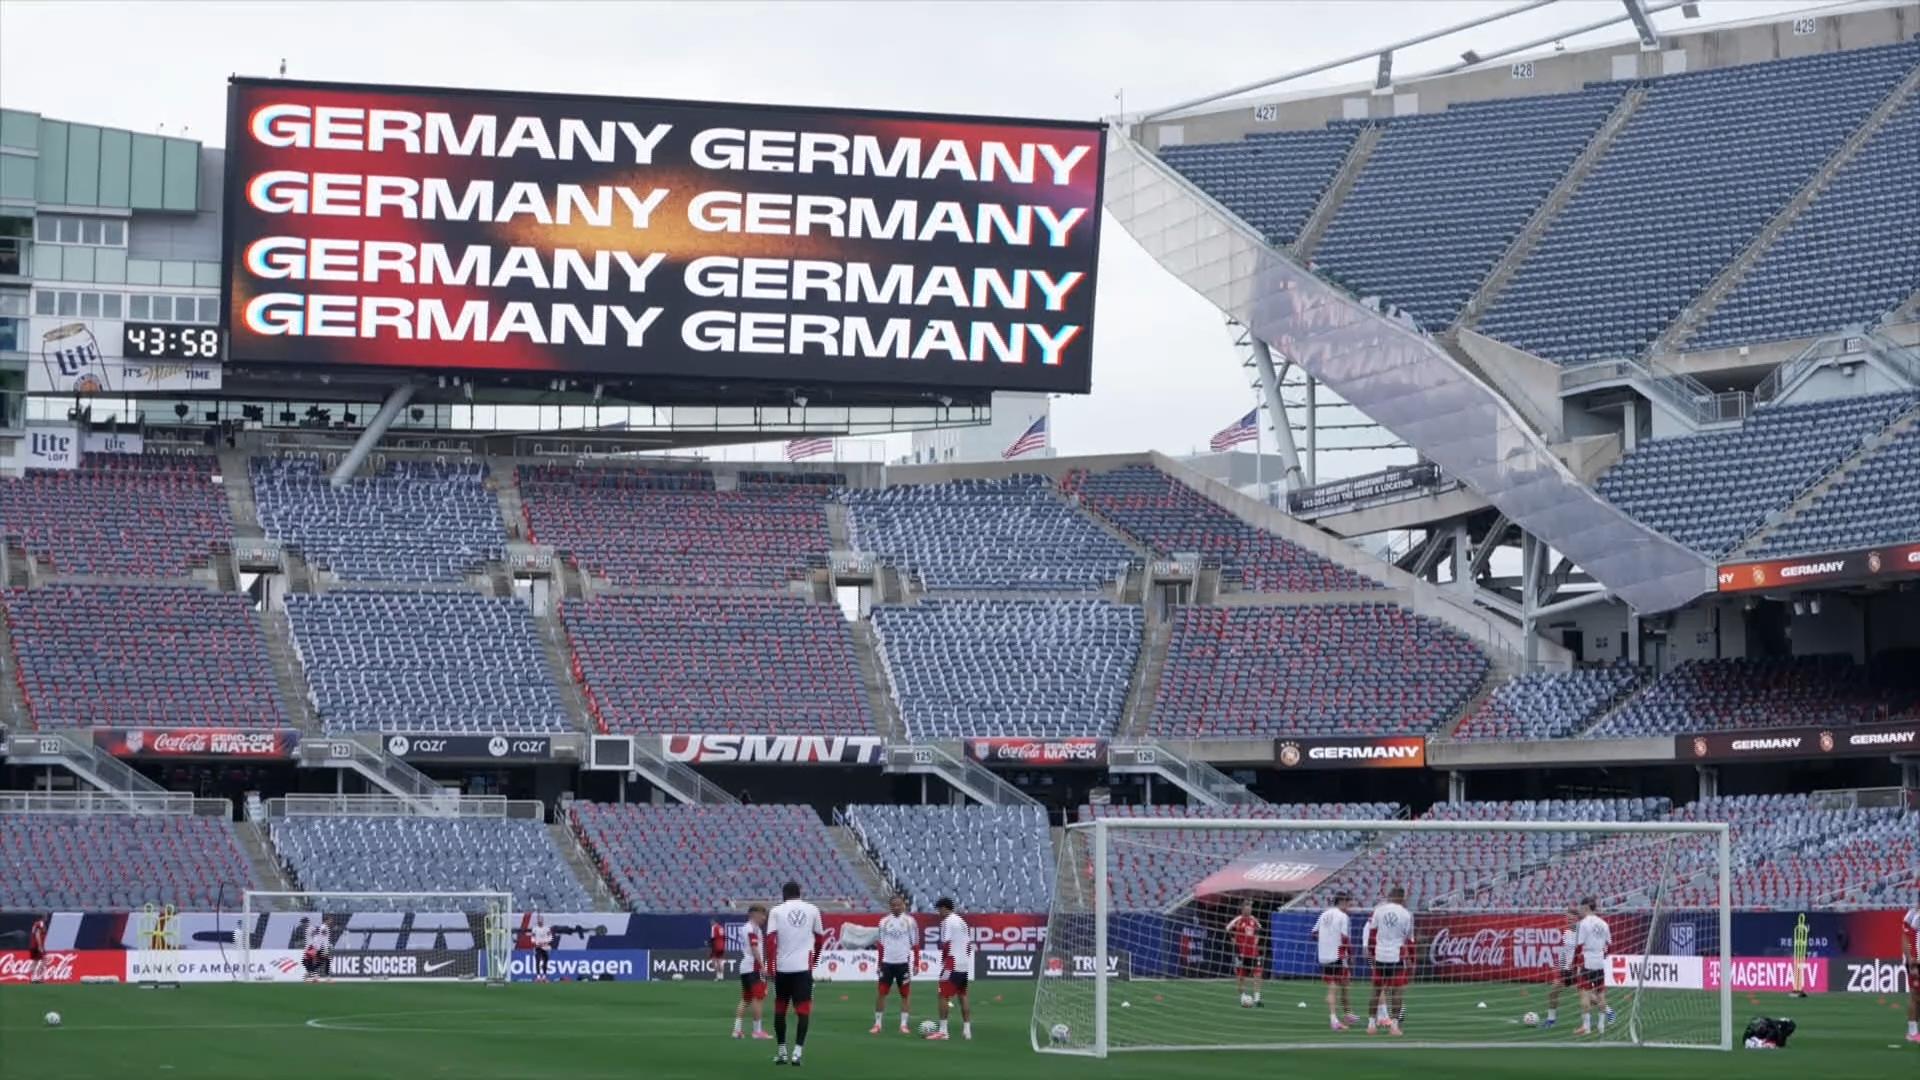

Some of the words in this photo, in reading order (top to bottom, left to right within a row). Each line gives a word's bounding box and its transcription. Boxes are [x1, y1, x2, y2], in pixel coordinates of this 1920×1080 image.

[1795, 19, 1815, 33] 429
[1513, 63, 1532, 77] 428
[1256, 106, 1275, 120] 427
[249, 104, 672, 164] GERMANY
[690, 127, 1091, 185] GERMANY
[247, 170, 670, 228] GERMANY
[687, 191, 1089, 246] GERMANY
[244, 236, 667, 292] GERMANY
[683, 256, 1086, 311] GERMANY
[243, 293, 664, 347] GERMANY
[681, 310, 1083, 365] GERMANY
[128, 328, 218, 357] 43:58
[55, 341, 97, 376] Lite
[186, 369, 210, 380] TIME
[32, 433, 70, 456] Lite
[104, 437, 126, 449] Lite
[48, 453, 69, 462] LOFT
[1780, 560, 1845, 577] GERMANY
[211, 733, 274, 742] SEND-OFF
[1732, 738, 1801, 750] GERMANY
[1850, 732, 1915, 745] GERMANY
[211, 742, 274, 752] MATCH
[413, 740, 447, 752] razr
[512, 740, 546, 752] razr
[662, 734, 881, 763] USMNT
[1309, 746, 1419, 759] GERMANY
[1044, 750, 1096, 759] MATCH
[925, 926, 1048, 942] SD-OFF
[986, 955, 1033, 970] TRULY
[1073, 956, 1118, 970] TRY
[1513, 946, 1565, 968] MAT
[133, 963, 173, 974] BANK
[177, 963, 197, 974] OF
[200, 963, 267, 974] AMERICA
[363, 956, 417, 974] SOCCER
[653, 959, 737, 973] MARRIOTT
